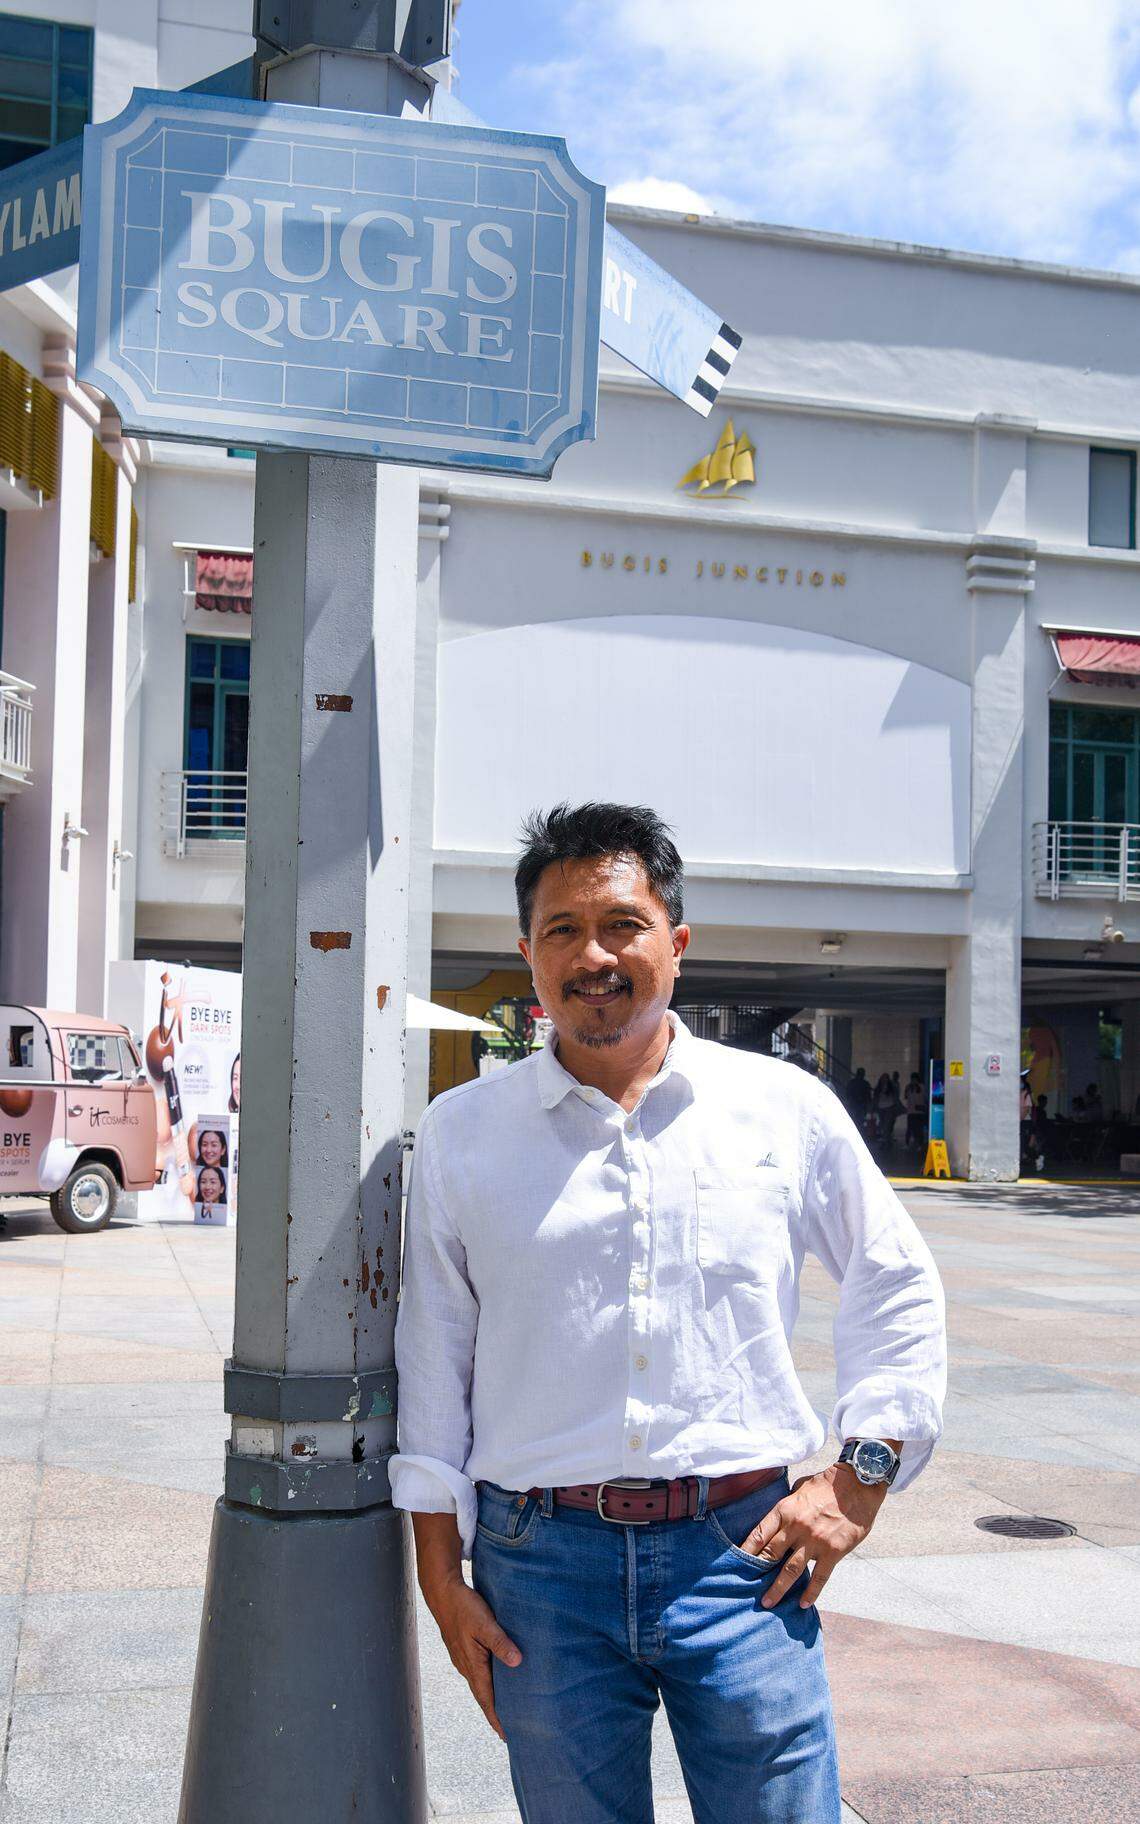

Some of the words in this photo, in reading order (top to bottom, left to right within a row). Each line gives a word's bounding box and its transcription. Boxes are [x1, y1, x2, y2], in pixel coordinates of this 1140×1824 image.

[178, 190, 518, 305] BUGIS
[602, 257, 638, 325] RT
[177, 281, 515, 363] SQUARE
[580, 549, 669, 575] BUGIS
[695, 560, 848, 588] JUNCTION
[191, 1007, 210, 1022] BYE
[213, 1009, 232, 1024] BYE
[190, 1023, 208, 1032] DARK
[211, 1025, 231, 1035] SPOTS
[90, 1107, 110, 1128] it
[4, 1133, 31, 1146] BYE
[0, 1147, 31, 1157] SPOTS
